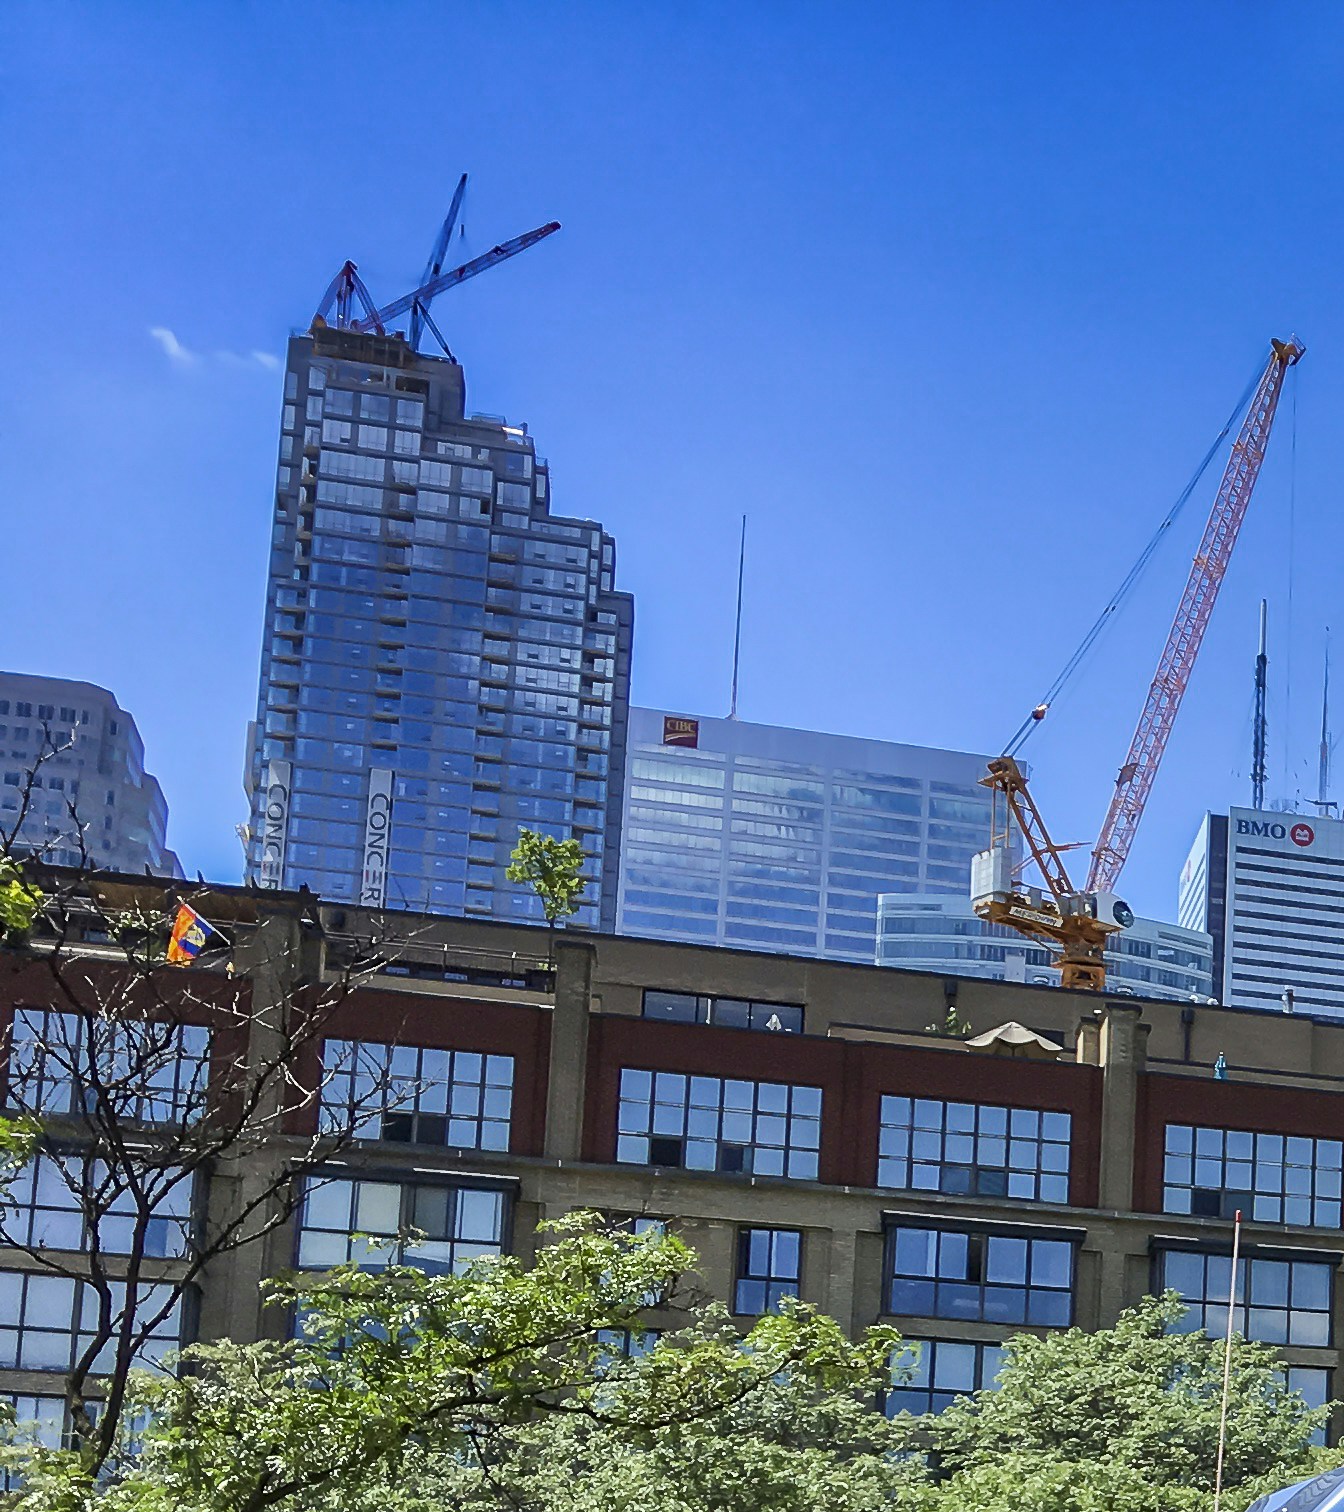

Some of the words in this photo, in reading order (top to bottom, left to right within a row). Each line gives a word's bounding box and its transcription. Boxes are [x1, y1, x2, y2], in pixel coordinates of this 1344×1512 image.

[666, 719, 697, 733] CIBC
[1236, 819, 1286, 840] BMO
[363, 793, 390, 907] CONCER
